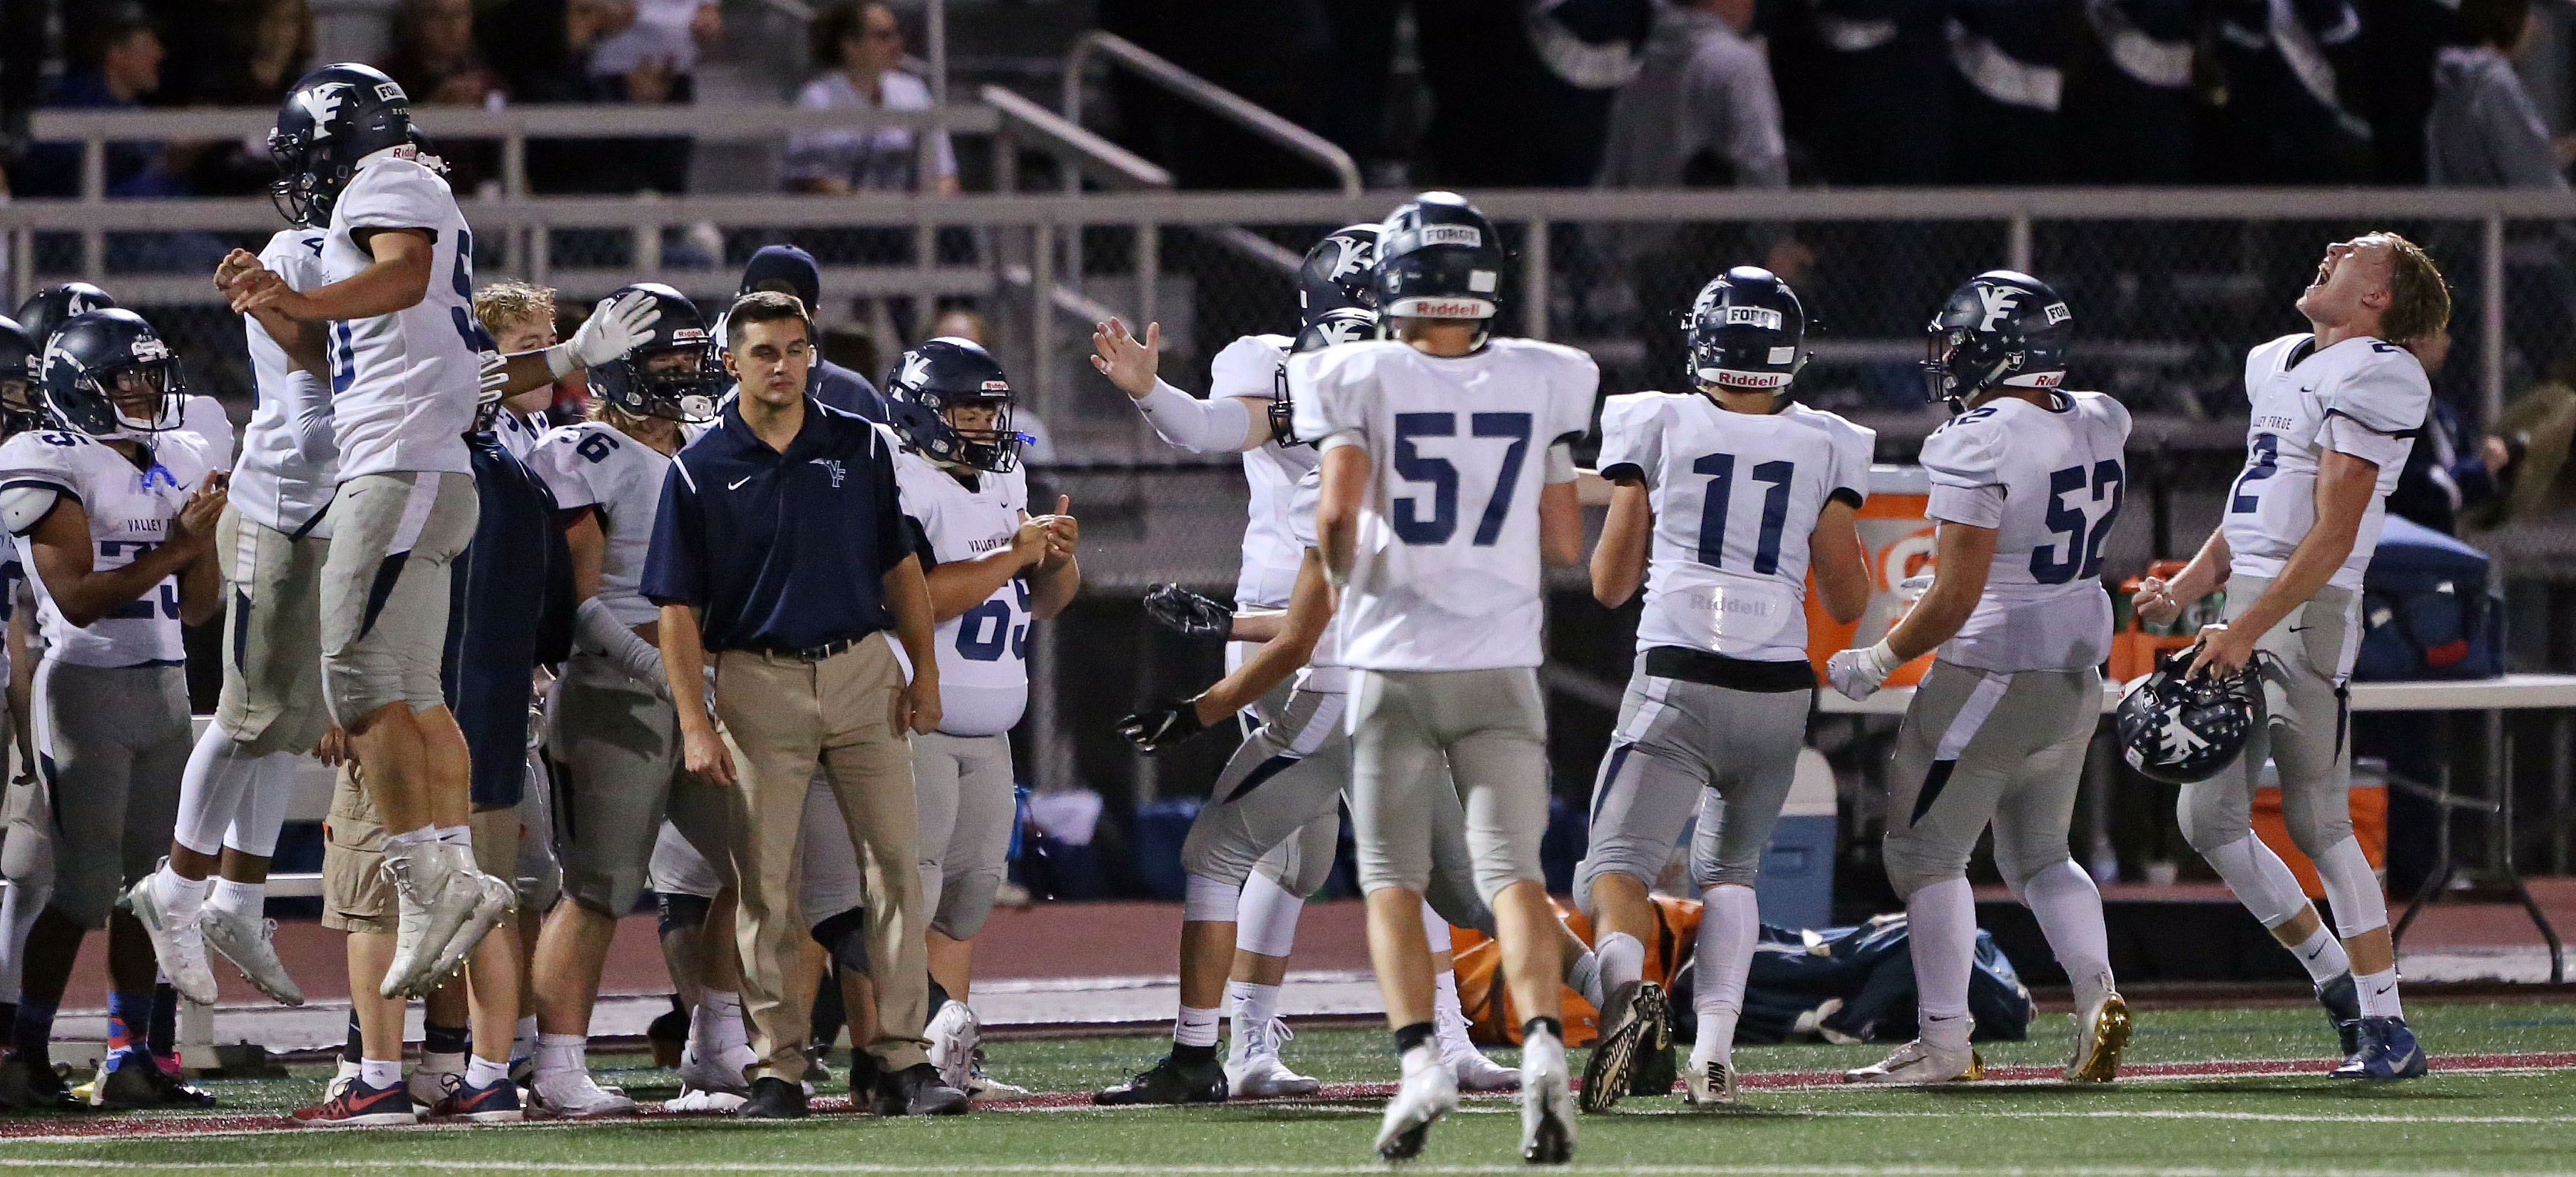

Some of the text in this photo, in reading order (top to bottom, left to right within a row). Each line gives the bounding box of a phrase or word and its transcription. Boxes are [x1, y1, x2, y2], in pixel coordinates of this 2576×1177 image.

[1416, 301, 1481, 315] Riddell
[1719, 372, 1779, 386] Riddell
[2268, 416, 2292, 430] FORGE
[1394, 412, 1533, 546] 57
[2232, 432, 2278, 513] 2
[1693, 452, 1794, 576] 11
[128, 519, 161, 532] VALLEY
[2029, 459, 2123, 584] 52
[967, 539, 997, 552] VALLEY
